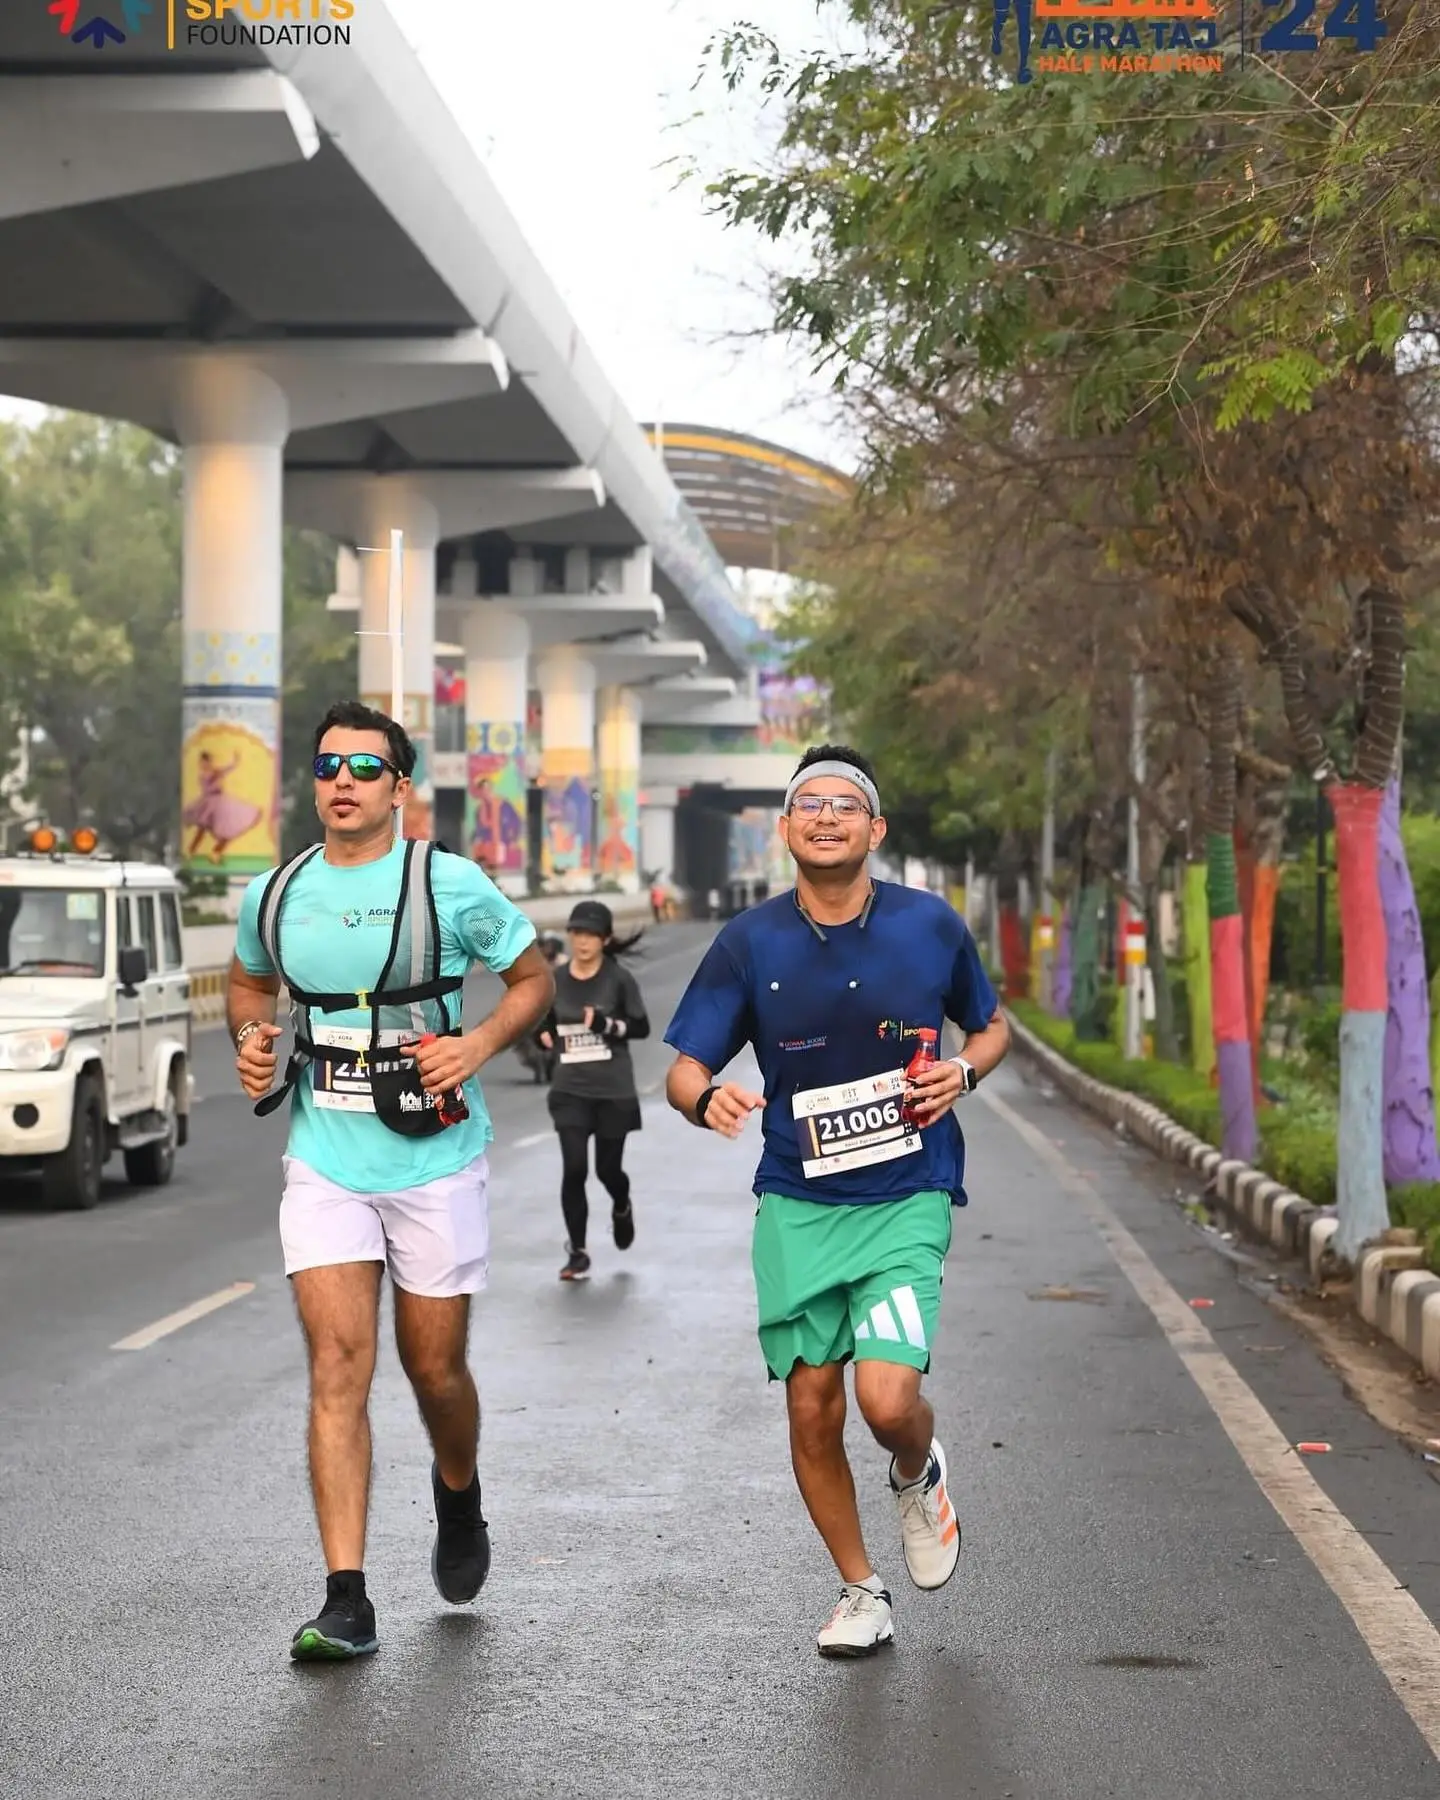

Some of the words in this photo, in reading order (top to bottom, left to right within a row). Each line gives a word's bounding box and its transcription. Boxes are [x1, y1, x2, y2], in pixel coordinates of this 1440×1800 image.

[368, 908, 398, 916] AGRA
[480, 918, 507, 950] BIBHAB
[904, 1028, 920, 1036] SPO
[818, 1100, 900, 1141] 21006
